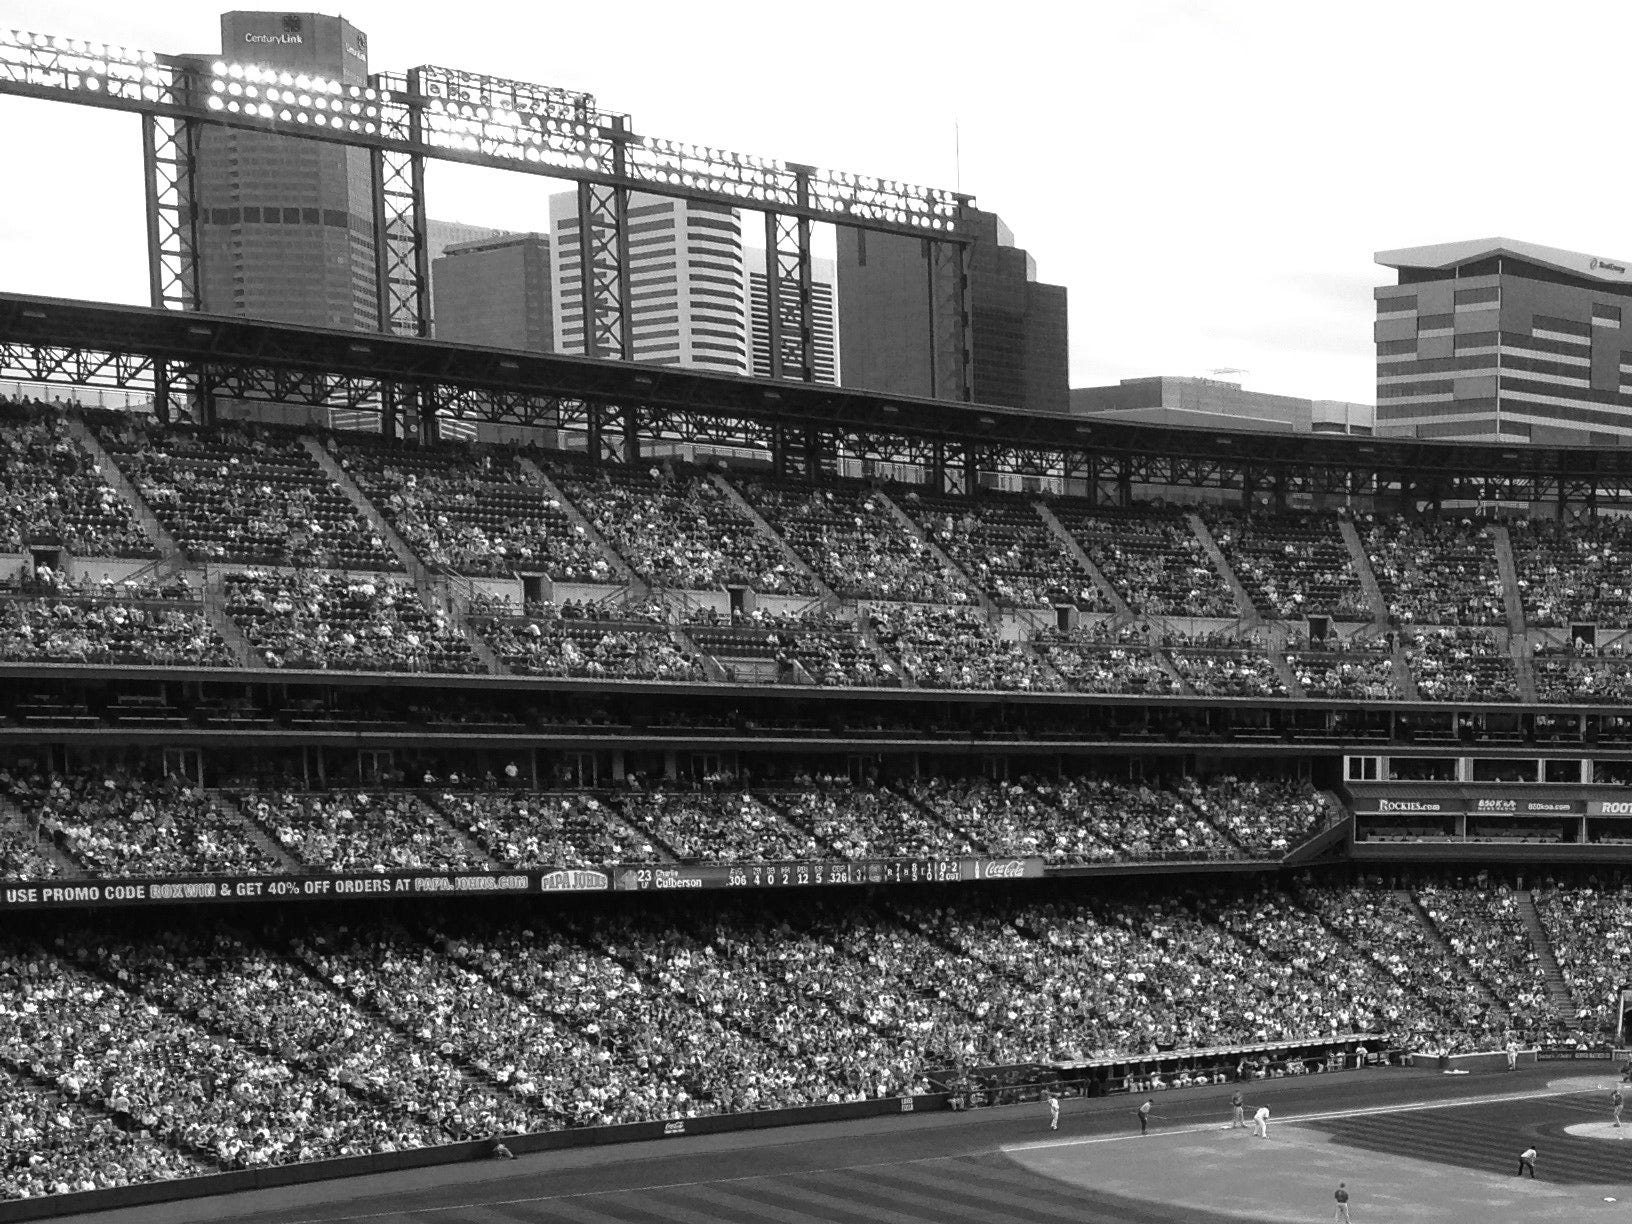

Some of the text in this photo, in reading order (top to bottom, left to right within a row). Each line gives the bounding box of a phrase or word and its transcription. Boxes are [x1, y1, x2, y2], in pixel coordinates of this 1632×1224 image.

[245, 33, 303, 44] CenturyLink
[637, 869, 652, 881] 23
[726, 875, 746, 886] .306
[753, 875, 760, 885] 4
[767, 874, 775, 885] 0
[782, 873, 789, 884] 2
[797, 873, 809, 884] 12
[926, 872, 933, 881] 0
[656, 877, 702, 889] Culberson
[7, 888, 38, 903] USE
[43, 886, 100, 902] PROMO
[104, 885, 146, 900] CODE
[220, 883, 232, 896] &
[236, 882, 263, 896] GET
[267, 881, 300, 895] 40%
[304, 881, 331, 894] OFF
[335, 879, 391, 893] ORDERS
[395, 878, 411, 892] AT
